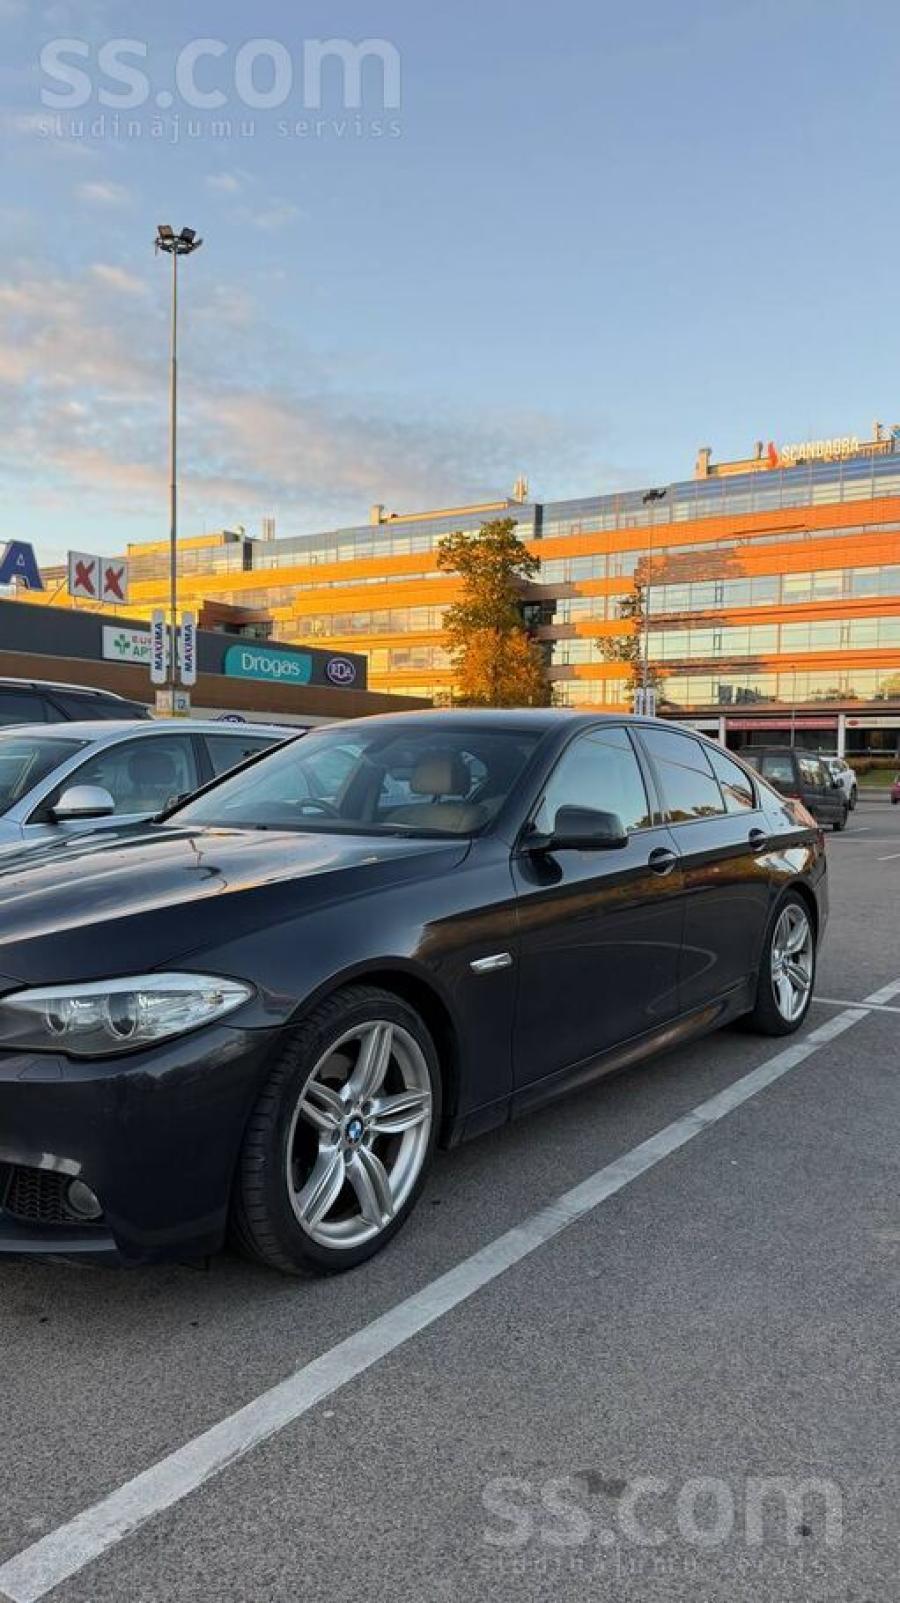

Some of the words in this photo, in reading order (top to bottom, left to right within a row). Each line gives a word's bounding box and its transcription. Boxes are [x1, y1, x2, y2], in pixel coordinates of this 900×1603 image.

[154, 622, 163, 670] MAXIMA
[184, 624, 193, 672] MAXIMA
[242, 653, 301, 678] Drogas
